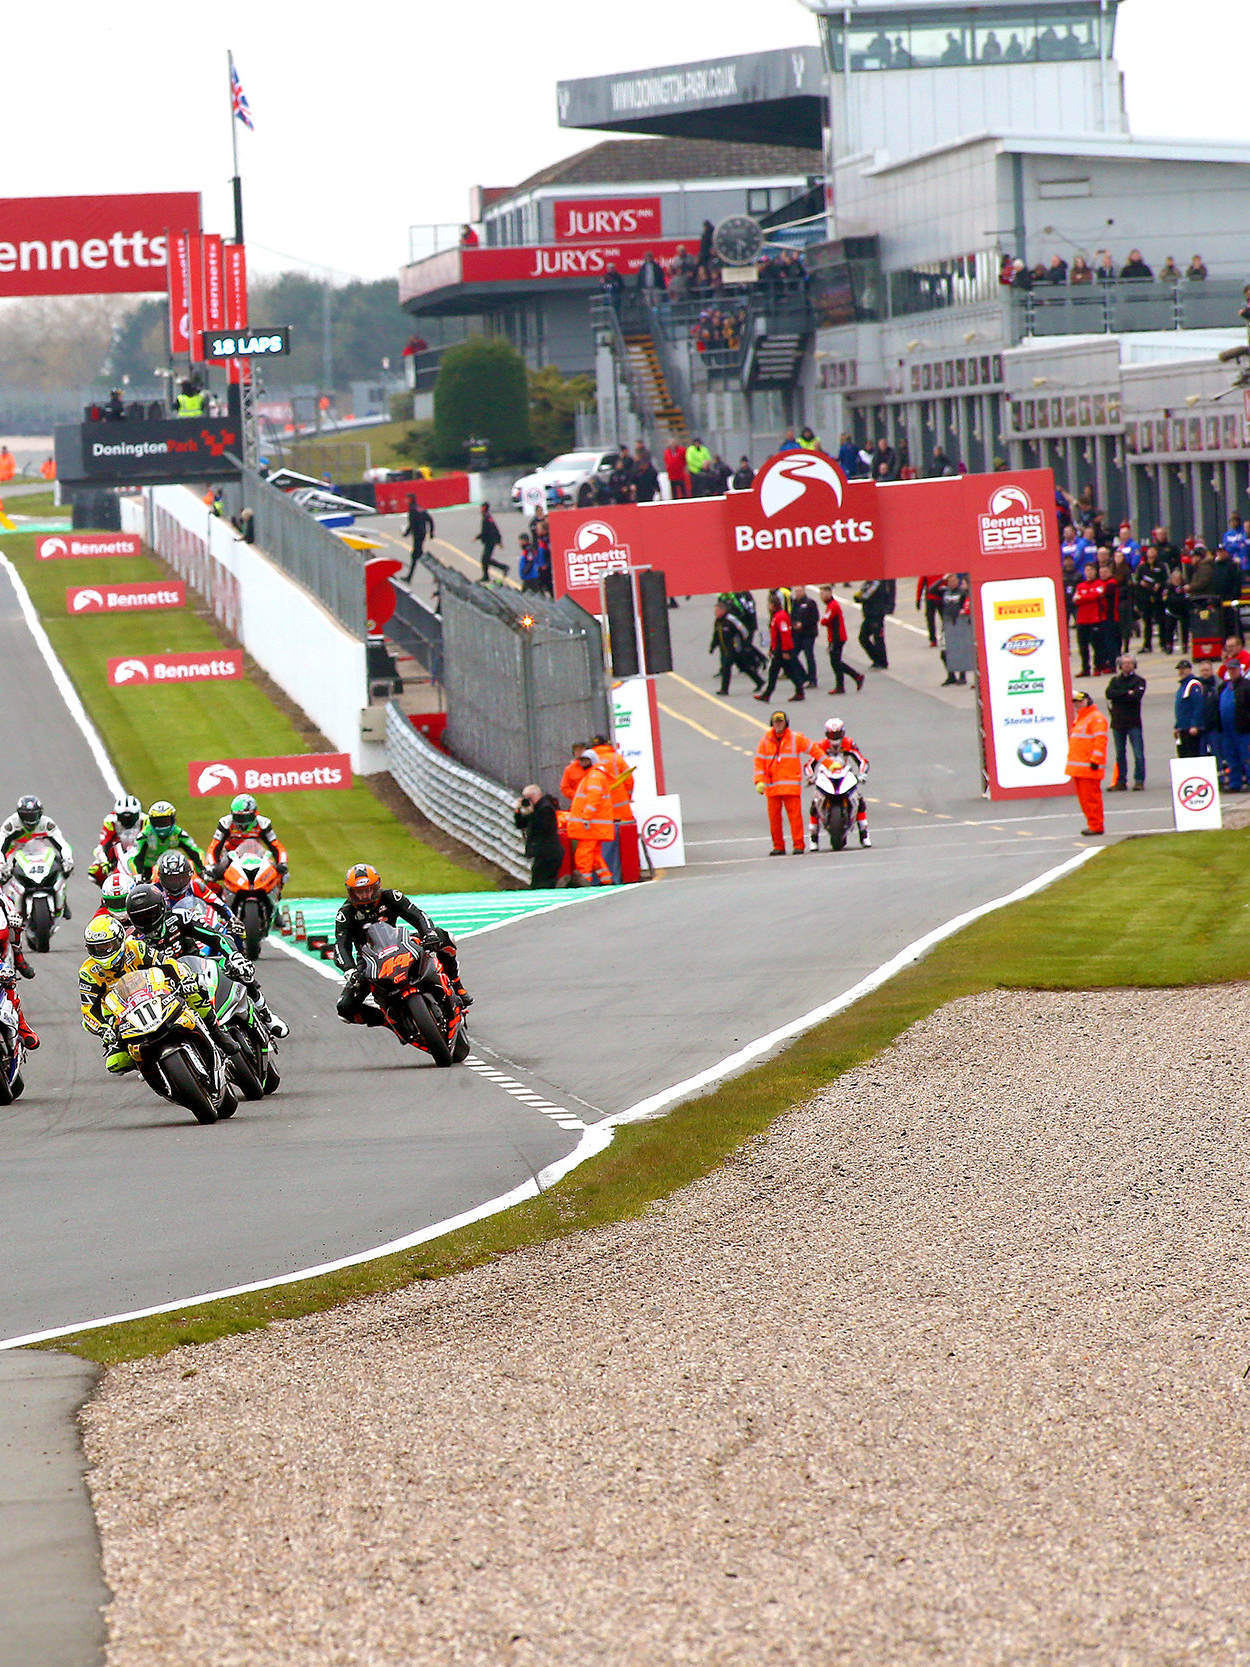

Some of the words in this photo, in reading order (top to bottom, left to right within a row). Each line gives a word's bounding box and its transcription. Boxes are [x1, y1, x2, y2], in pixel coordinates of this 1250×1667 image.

[564, 208, 638, 238] JURYS
[531, 248, 606, 278] JURYS
[212, 338, 236, 356] 18
[238, 336, 283, 354] LAPS
[92, 438, 199, 458] DoningtonPark
[981, 514, 1041, 529] Bennetts
[735, 517, 874, 552] Bennetts
[982, 525, 1042, 547] BSB
[71, 540, 134, 555] Bennetts
[567, 550, 627, 564] Bennetts
[107, 590, 179, 607] Bennetts
[153, 660, 236, 680] Bennetts
[244, 766, 342, 790] Bennetts
[1184, 784, 1209, 798] 60
[647, 822, 672, 836] 60
[28, 865, 45, 875] 45
[378, 951, 414, 979] 44
[134, 1002, 157, 1027] 11
